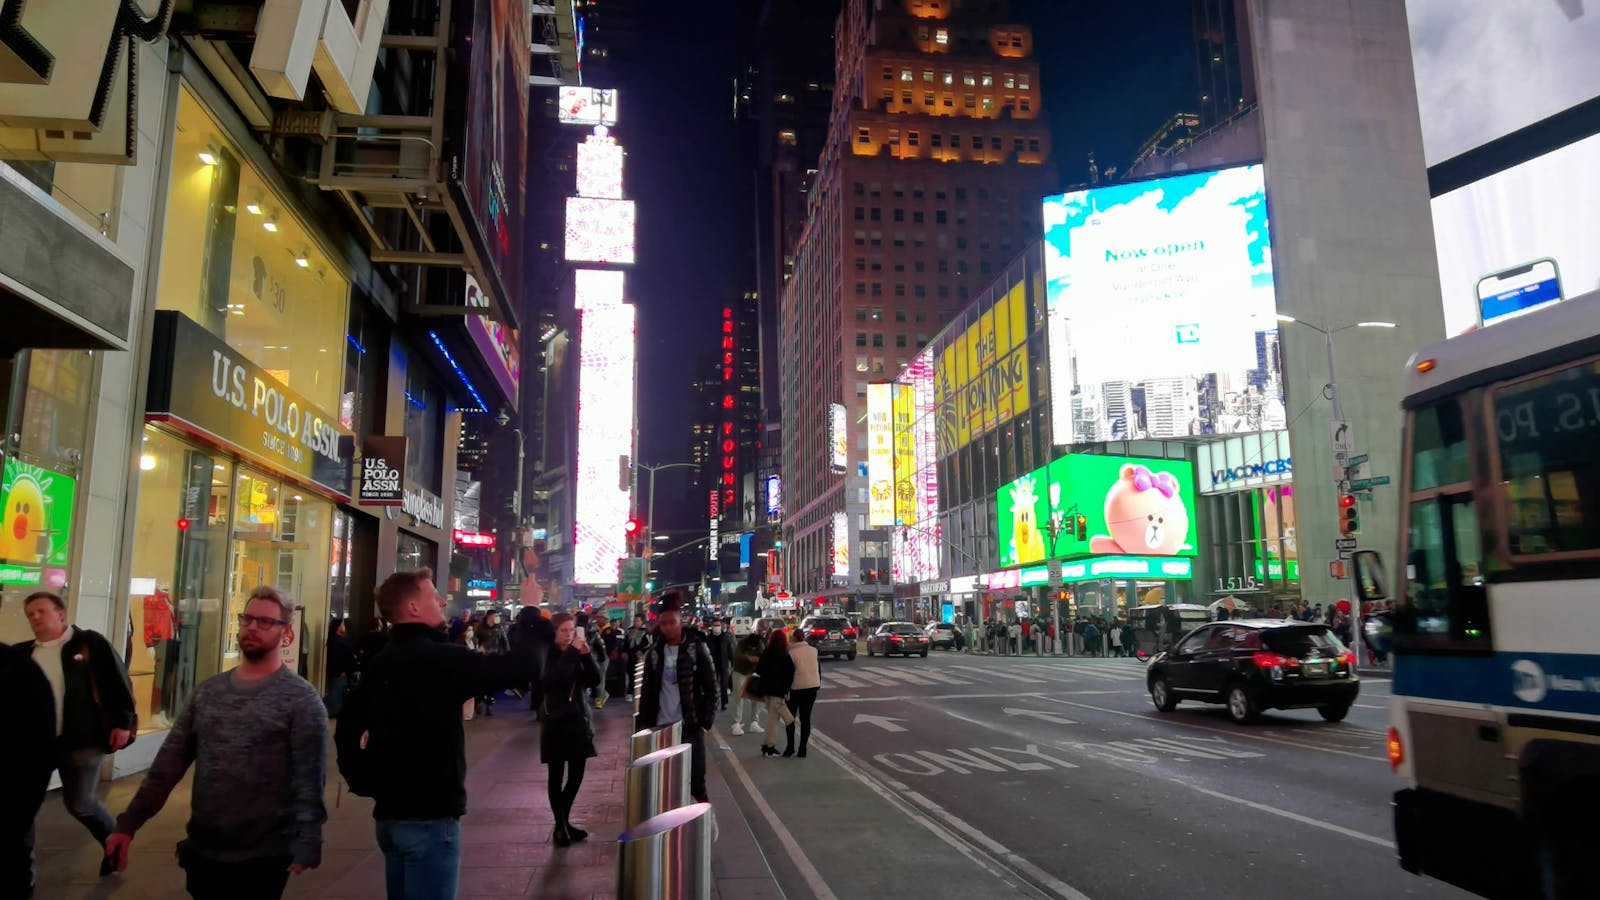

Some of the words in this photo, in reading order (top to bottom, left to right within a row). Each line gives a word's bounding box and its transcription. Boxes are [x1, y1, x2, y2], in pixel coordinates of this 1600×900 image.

[1104, 248, 1149, 262] Now
[1153, 240, 1205, 256] open
[975, 330, 995, 365] THE
[987, 353, 1023, 413] KING
[212, 350, 248, 411] U.S.
[251, 376, 300, 439] POLO
[300, 411, 342, 464] ASSN.
[261, 431, 287, 455] SINCE
[363, 469, 399, 480] POLO
[364, 458, 389, 469] U.S.
[721, 422, 736, 505] YOUNG
[361, 480, 401, 491] ASSN.
[402, 488, 433, 527] sunglass
[432, 496, 444, 530] hut
[709, 530, 719, 561] POWER
[1218, 575, 1256, 591] 1515
[872, 743, 1080, 777] ONLY
